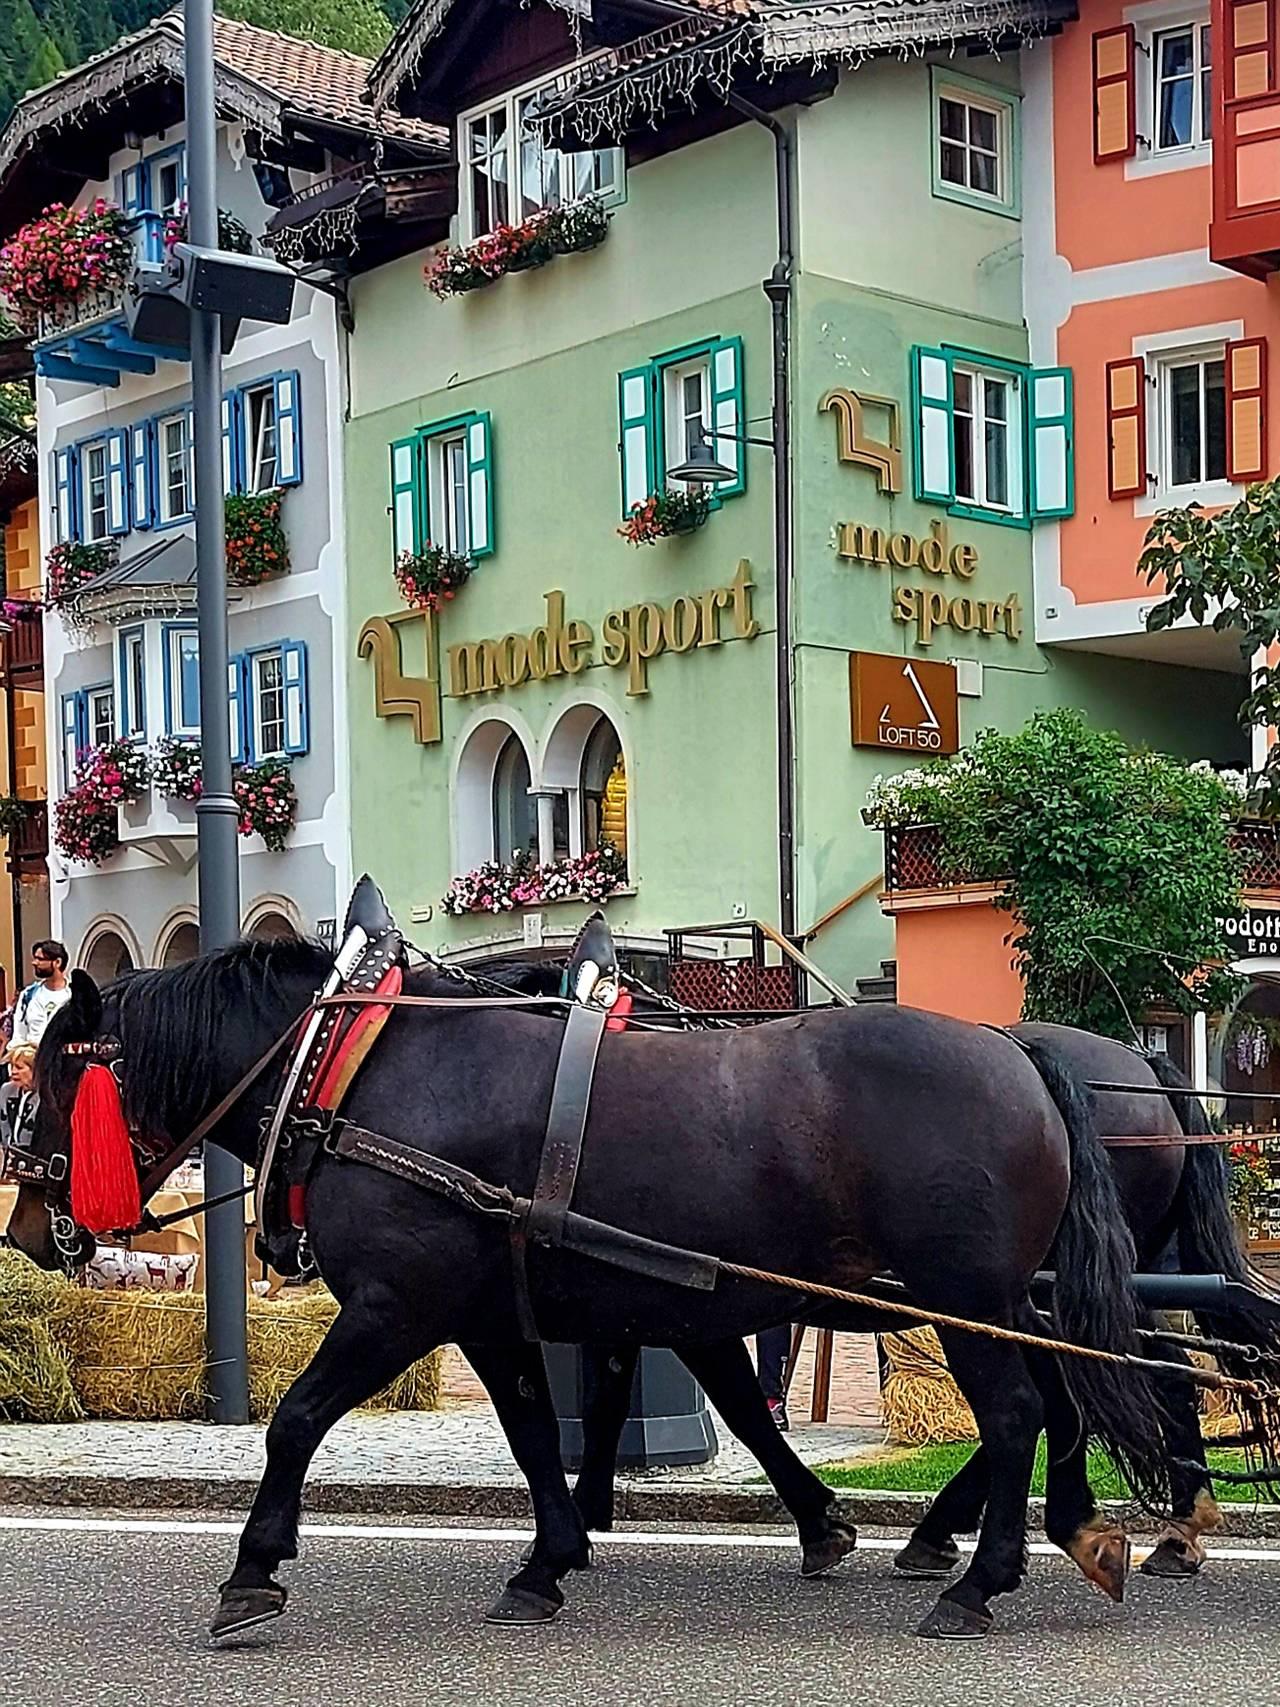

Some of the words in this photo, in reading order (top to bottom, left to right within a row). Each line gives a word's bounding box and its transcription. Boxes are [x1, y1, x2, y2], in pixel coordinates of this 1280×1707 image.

[838, 519, 979, 579] mode
[447, 588, 594, 698] mode
[602, 557, 760, 699] sport
[892, 586, 1022, 647] sport
